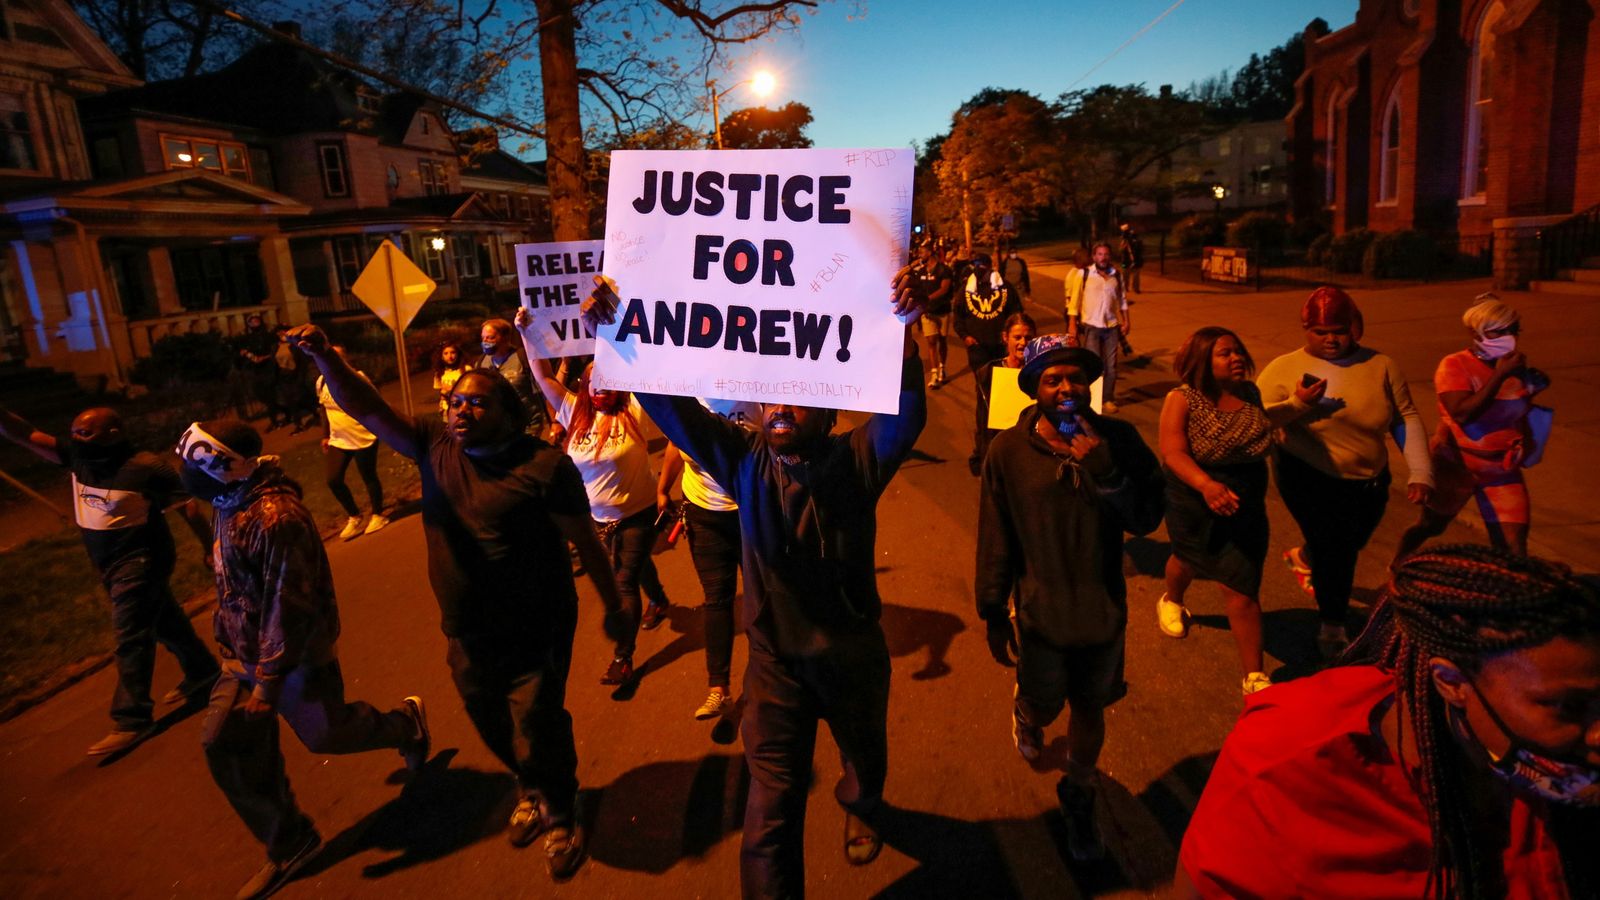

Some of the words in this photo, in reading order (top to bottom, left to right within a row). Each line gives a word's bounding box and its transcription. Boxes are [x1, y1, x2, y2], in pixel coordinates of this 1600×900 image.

[844, 149, 896, 168] #RIP
[632, 170, 851, 224] JUSTICE
[693, 234, 795, 286] FOR
[809, 252, 849, 293] #BLM
[524, 283, 580, 309] THE
[614, 298, 853, 363] ANDREW!
